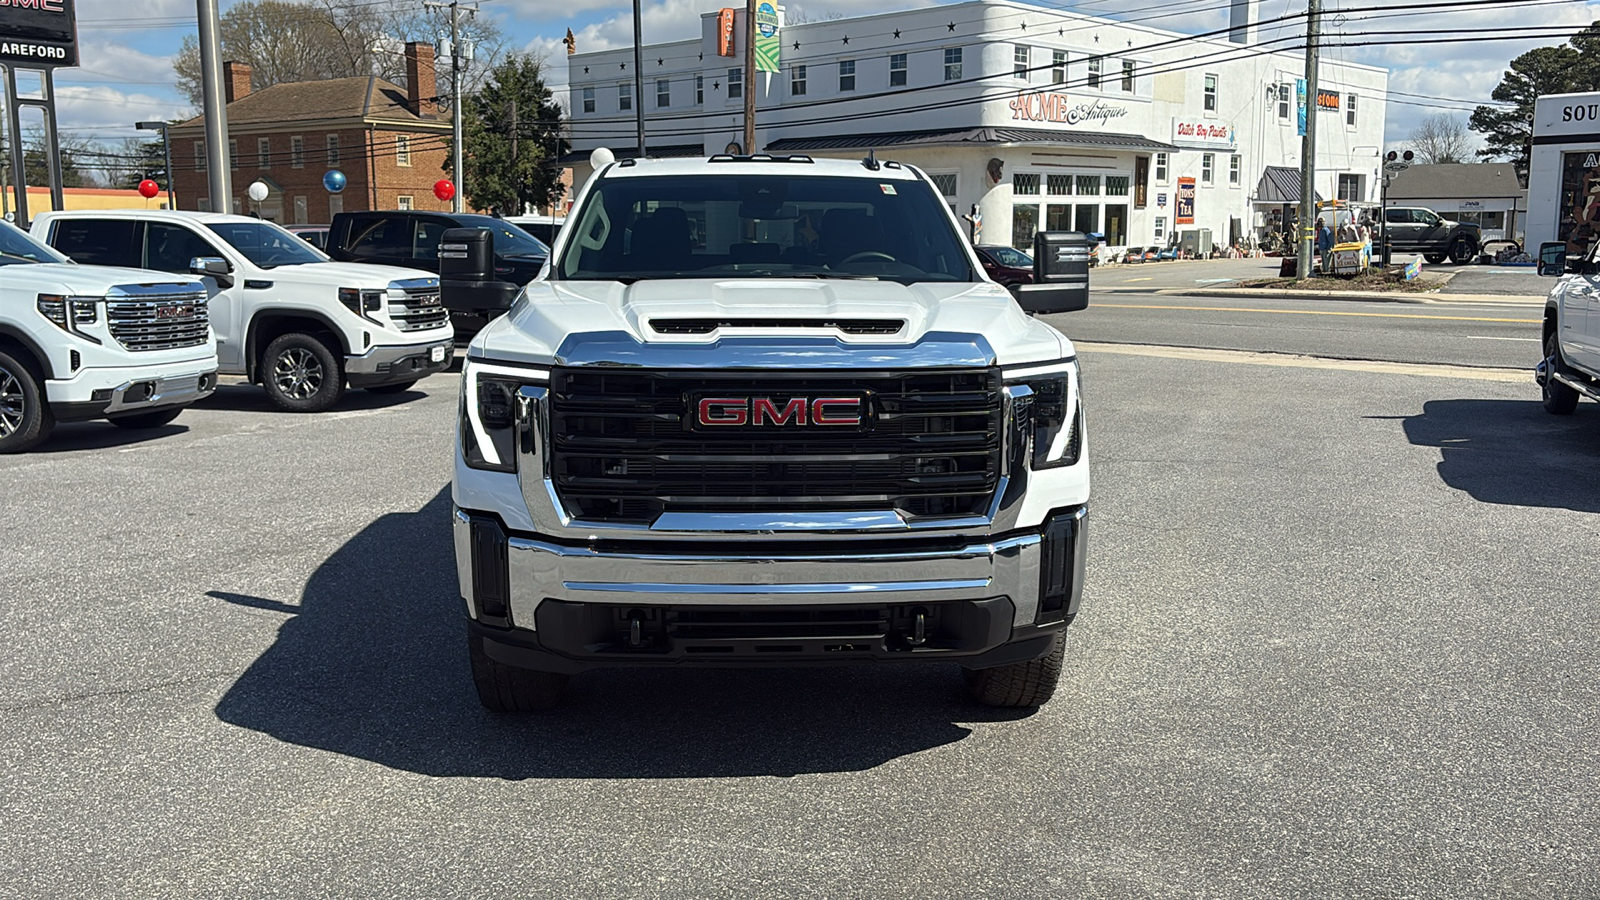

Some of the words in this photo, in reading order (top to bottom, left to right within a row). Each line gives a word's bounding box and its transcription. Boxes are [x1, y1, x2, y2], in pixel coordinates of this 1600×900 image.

[1, 42, 66, 59] AREFORD
[1009, 91, 1068, 123] ACME
[1081, 98, 1128, 126] Antiques
[1562, 104, 1599, 122] SOU
[1177, 122, 1195, 136] Dutch
[1196, 124, 1208, 140] Boy
[1208, 124, 1227, 138] Paints
[1179, 203, 1192, 215] TEA
[699, 397, 861, 426] GMC
